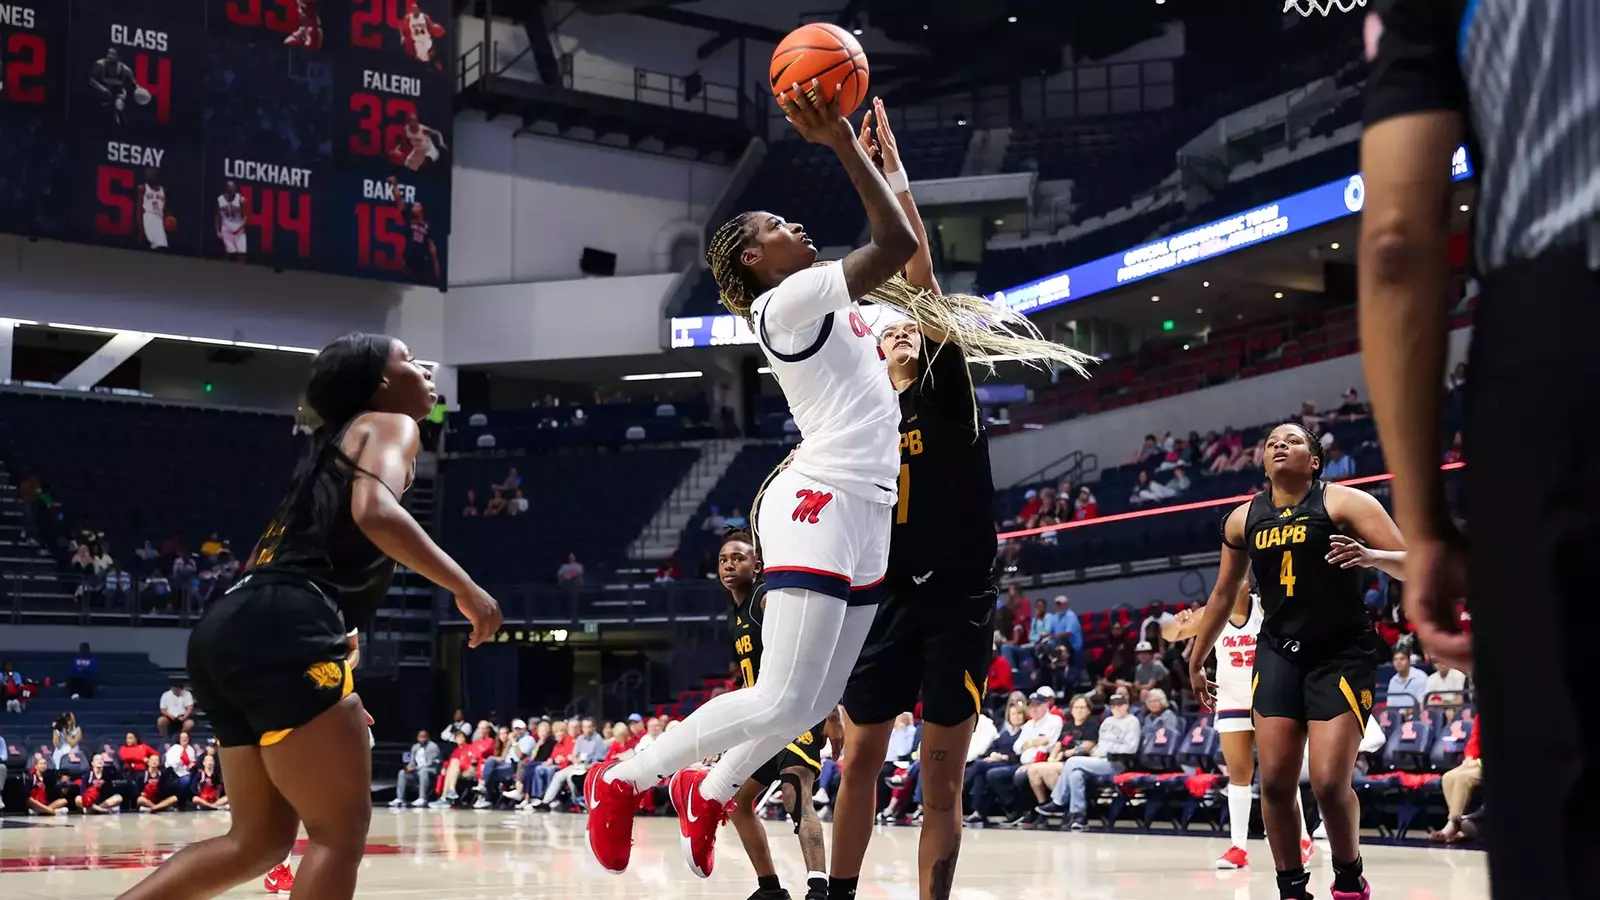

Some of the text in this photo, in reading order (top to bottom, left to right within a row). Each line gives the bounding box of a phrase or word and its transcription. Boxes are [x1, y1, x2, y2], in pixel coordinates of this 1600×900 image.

[110, 24, 168, 51] GLASS
[134, 53, 172, 124] 4
[363, 69, 421, 97] FALERU
[107, 141, 165, 168] SESAY
[224, 157, 311, 188] LOCKHART
[240, 184, 311, 258] 44
[354, 201, 407, 270] 15
[1255, 524, 1307, 550] UAPB
[1280, 550, 1296, 597] 4
